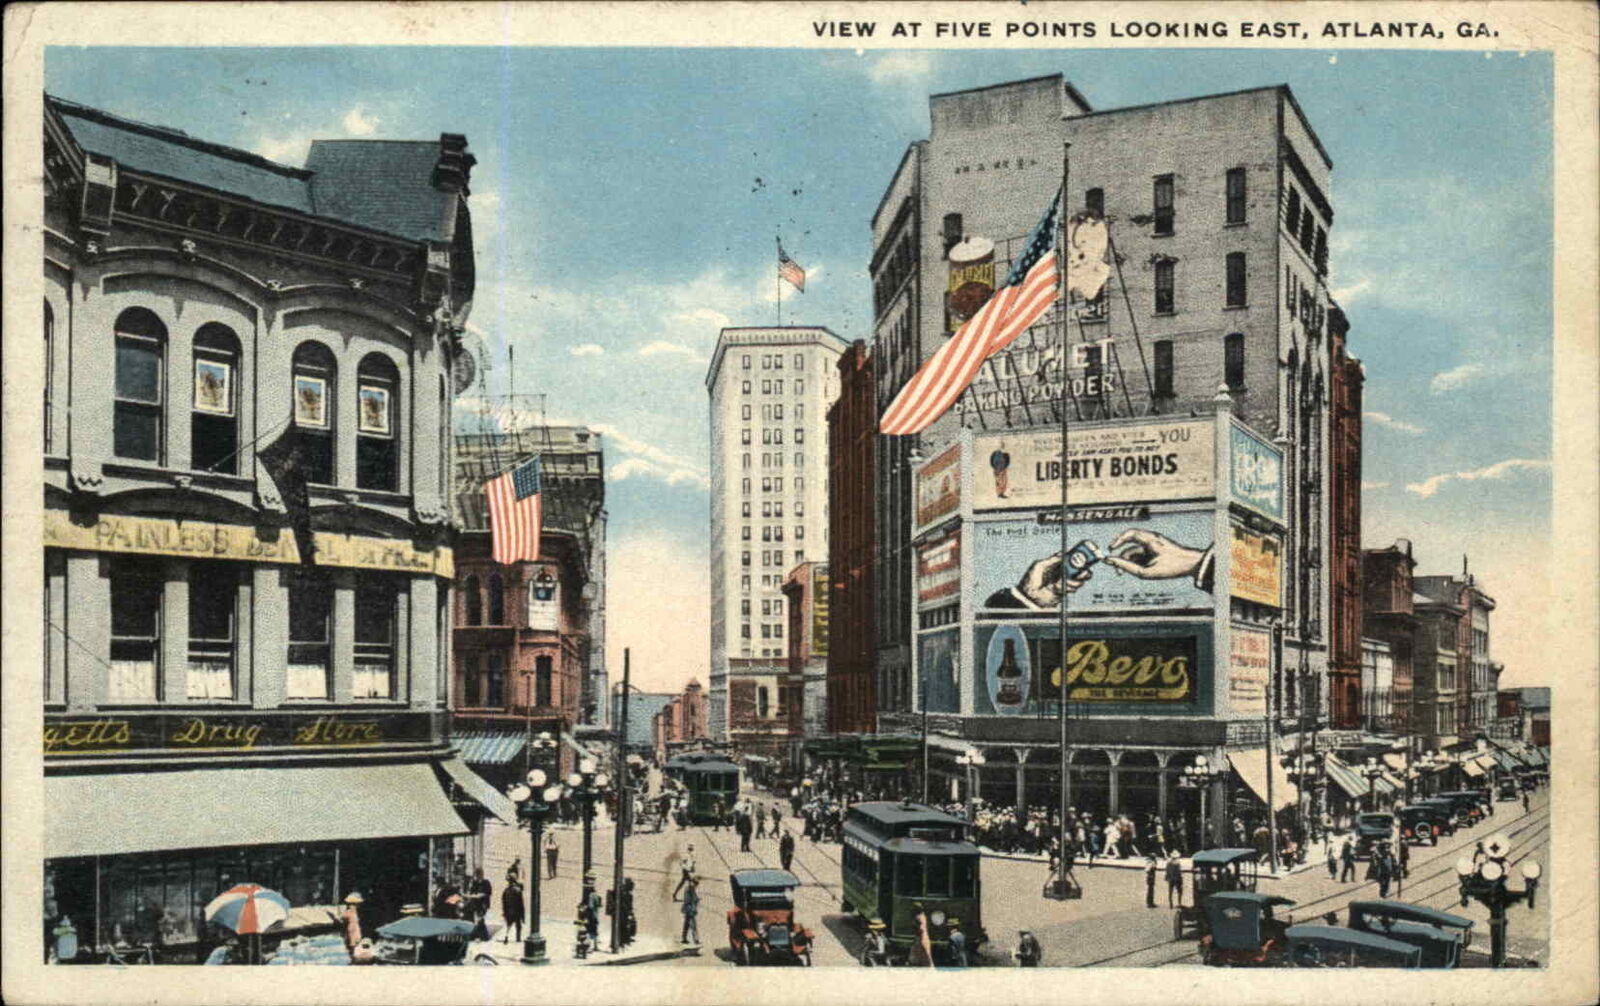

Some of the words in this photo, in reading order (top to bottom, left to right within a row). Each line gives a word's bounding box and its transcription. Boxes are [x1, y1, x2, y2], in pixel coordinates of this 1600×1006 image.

[1029, 373, 1116, 403] POWDER
[1159, 427, 1191, 444] YOU
[1036, 458, 1103, 482] LIBERTY
[1110, 453, 1178, 478] BONDS
[1051, 640, 1189, 688] Bevo
[173, 718, 264, 750] Drug
[296, 716, 382, 742] Store
